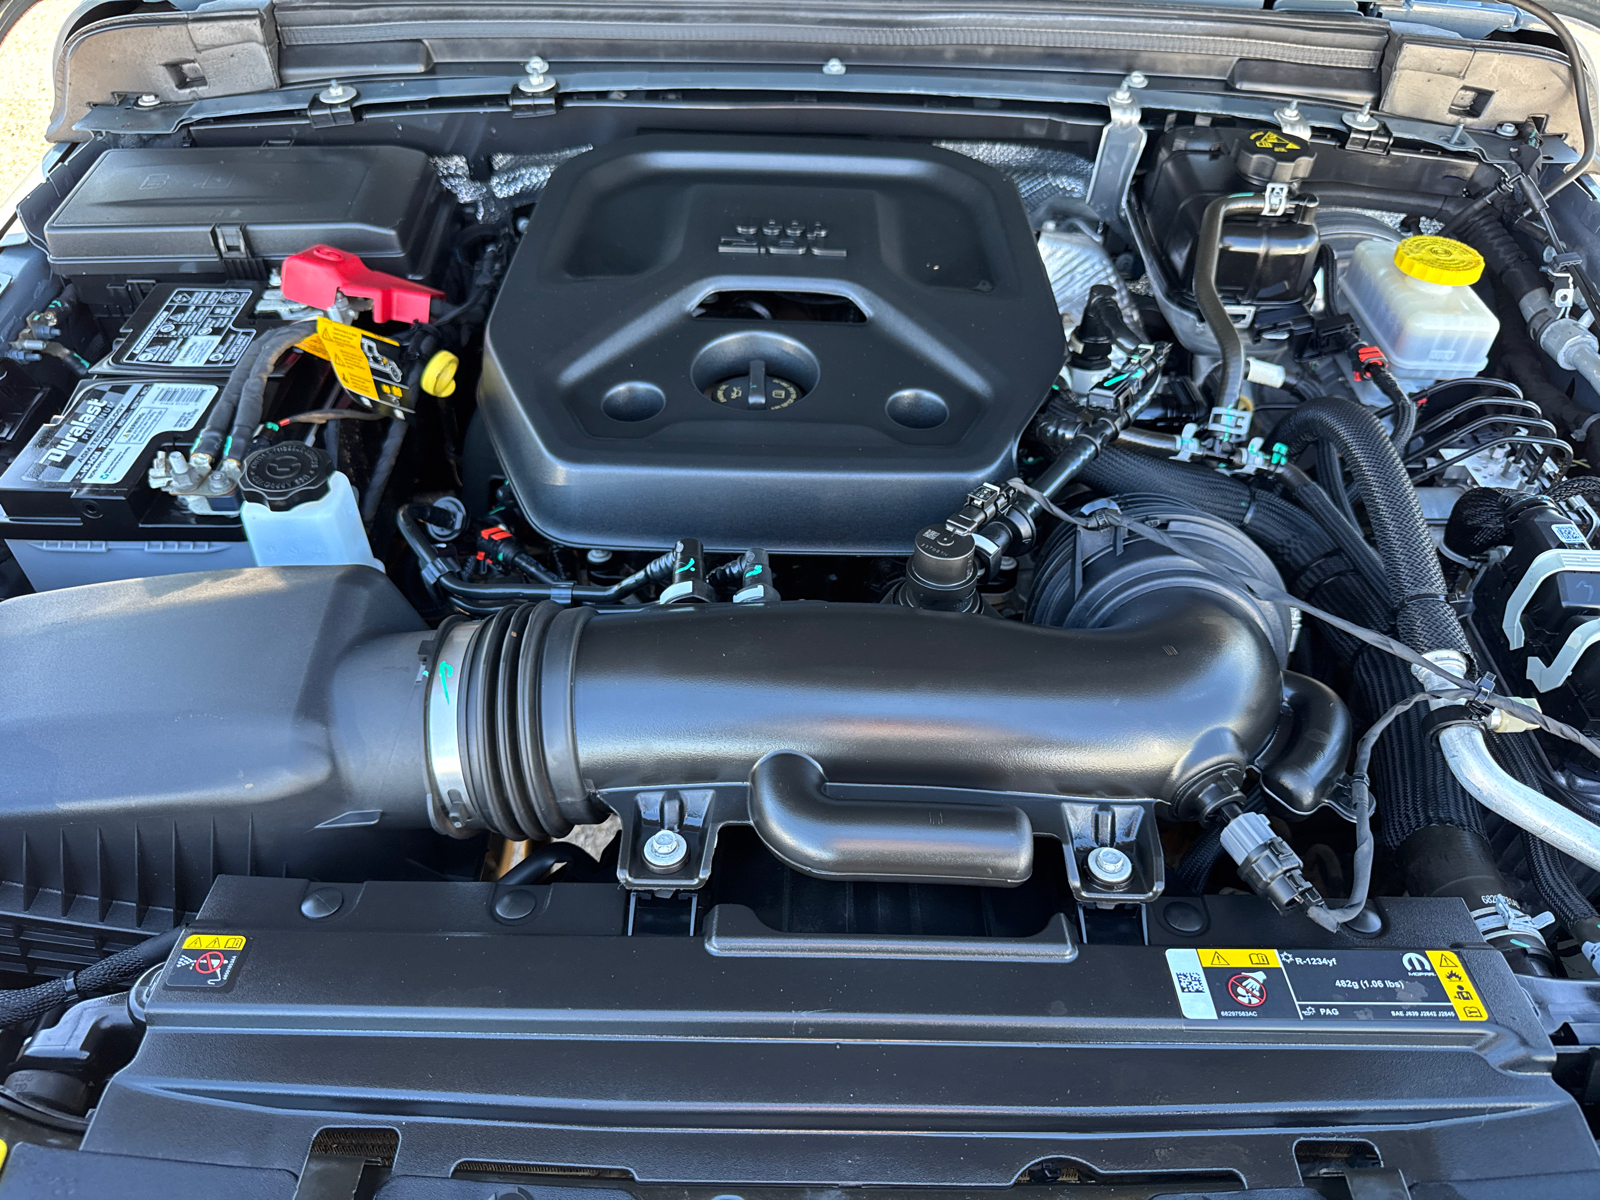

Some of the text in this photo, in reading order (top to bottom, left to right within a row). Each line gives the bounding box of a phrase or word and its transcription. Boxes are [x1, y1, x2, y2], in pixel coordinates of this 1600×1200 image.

[38, 398, 108, 464] Duralast
[82, 401, 115, 440] PLATINUM
[91, 404, 126, 448] TECHNOLOGY
[1295, 957, 1337, 967] R-1234yf
[1335, 979, 1405, 990] 482g (1.06 lbs)
[1319, 1007, 1340, 1016] PAG
